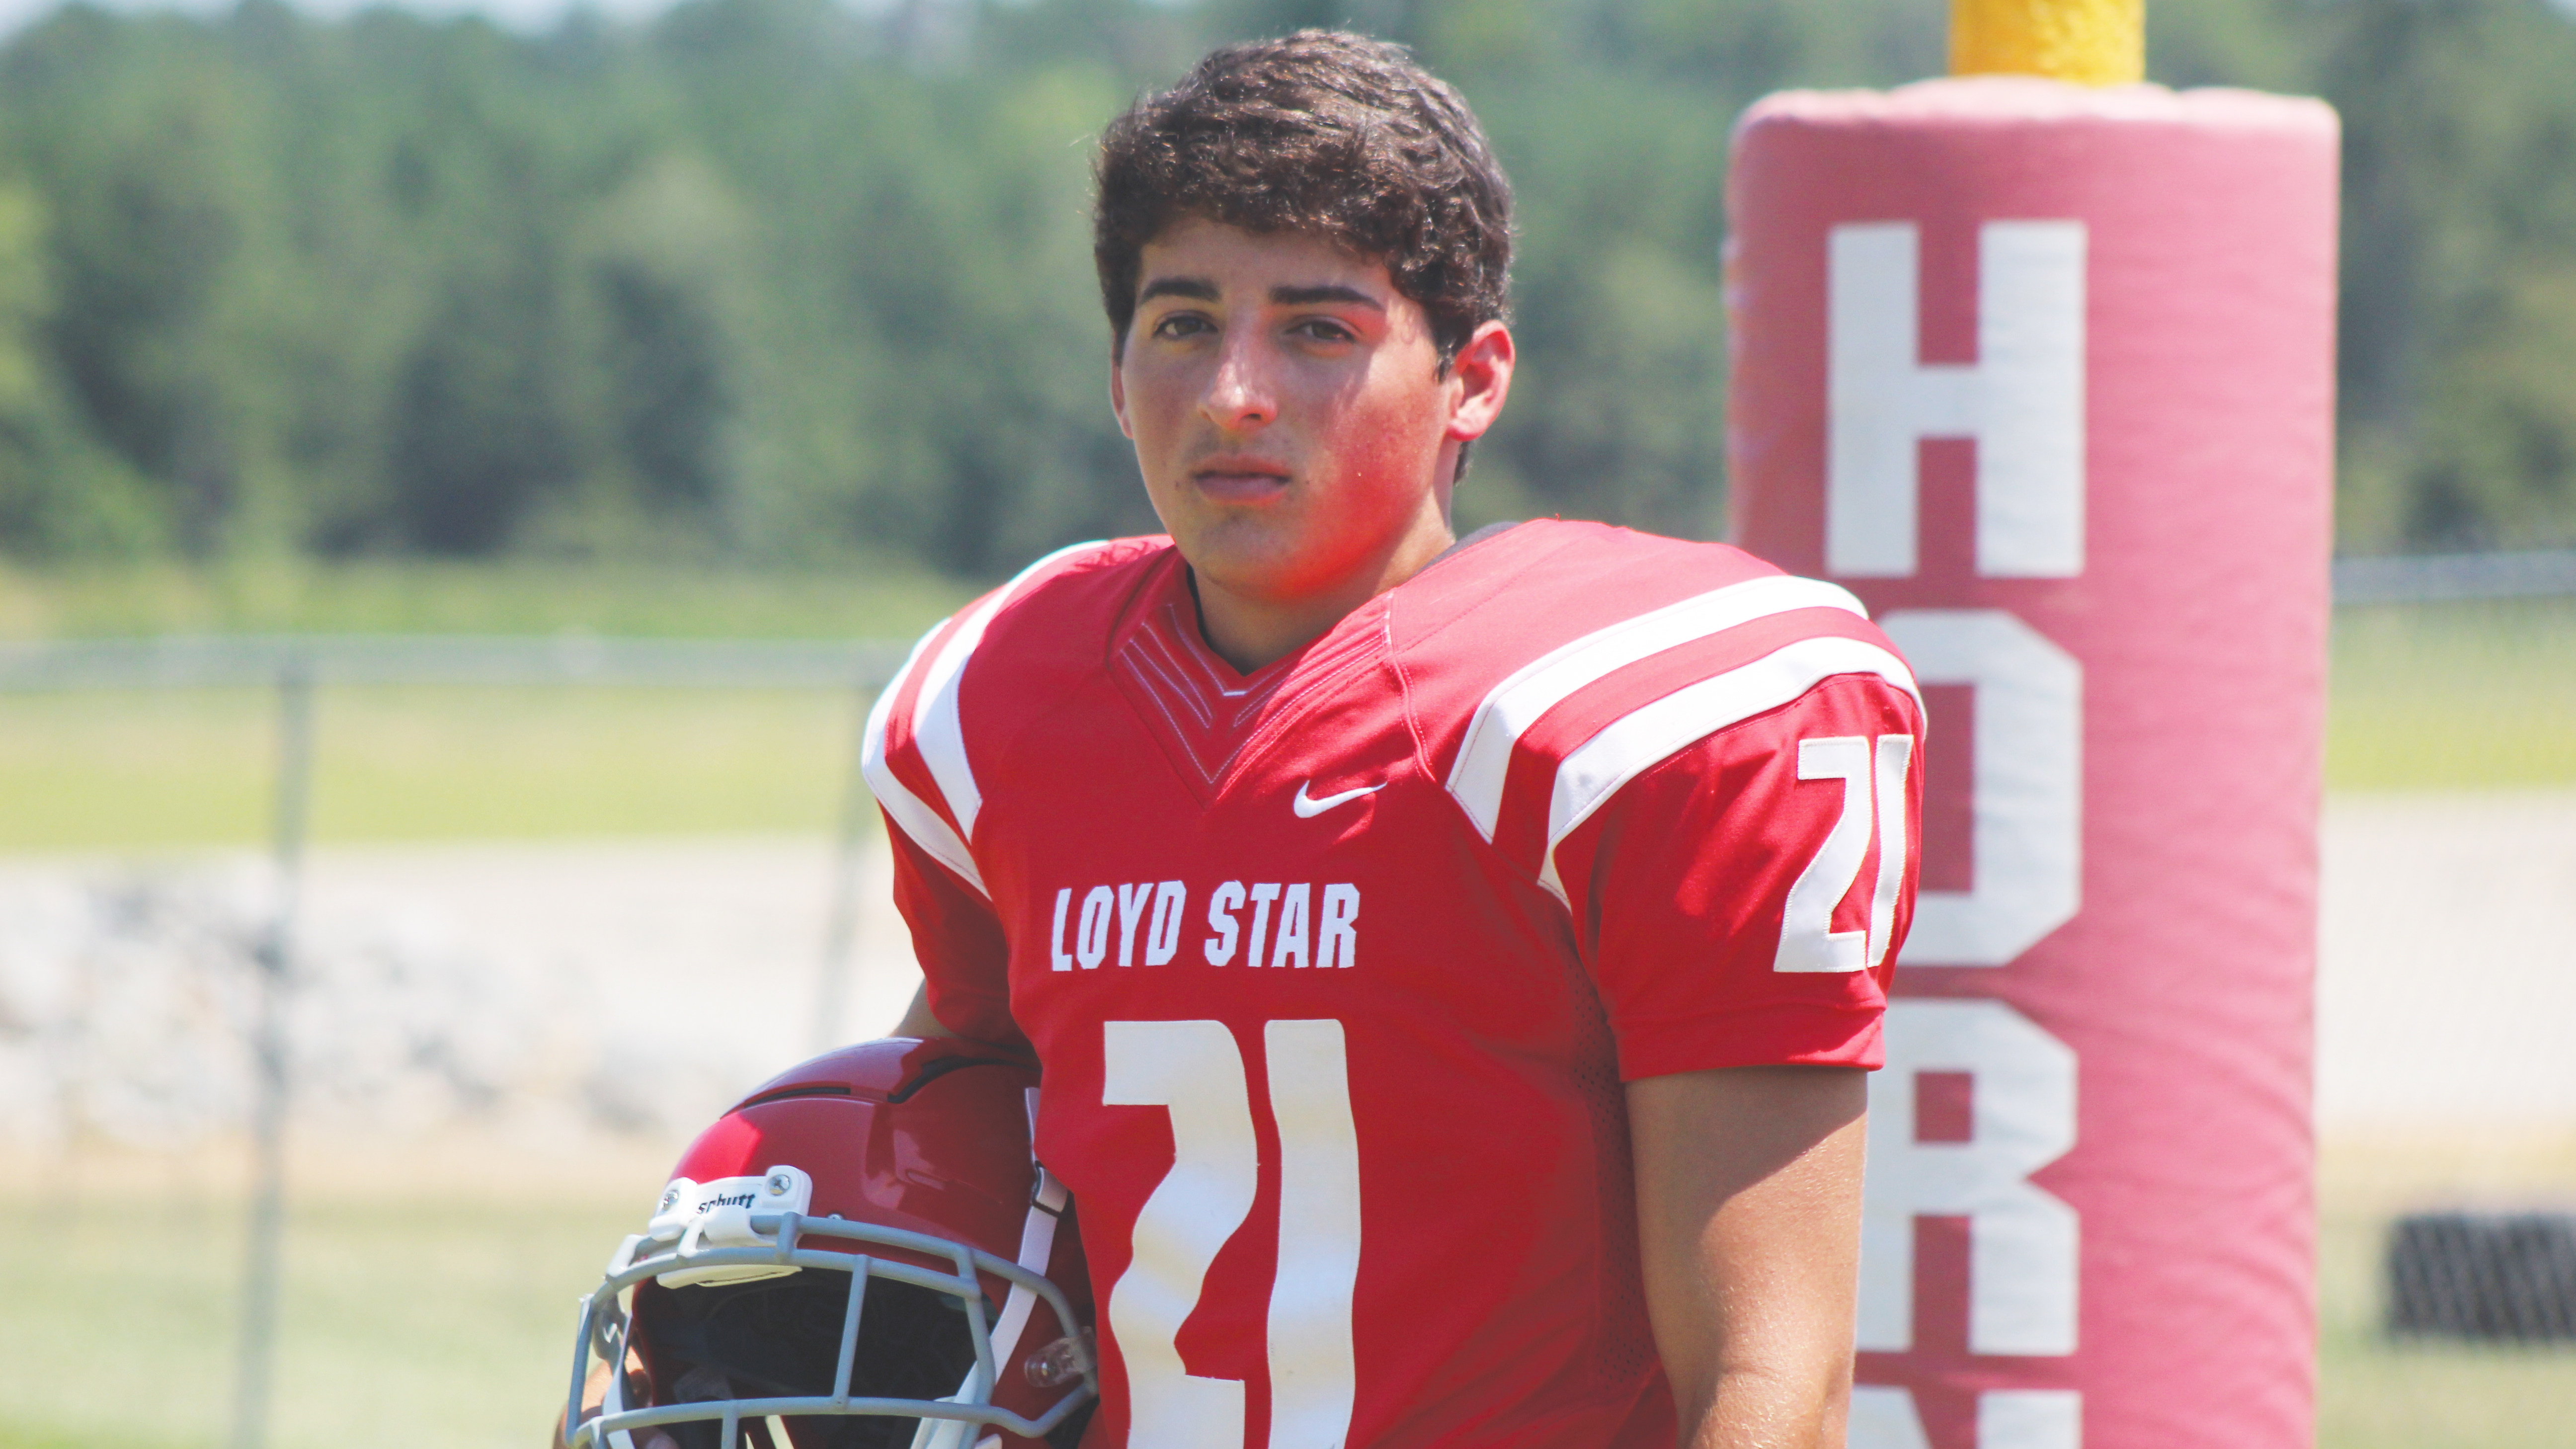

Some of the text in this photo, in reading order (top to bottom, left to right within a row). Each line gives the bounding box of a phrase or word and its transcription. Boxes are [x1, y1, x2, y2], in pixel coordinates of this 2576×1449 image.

[1051, 880, 1360, 971] LOYD STAR
[1773, 734, 1914, 972] 21
[1826, 221, 2086, 1449] HOR
[1102, 1019, 1362, 1449] 21
